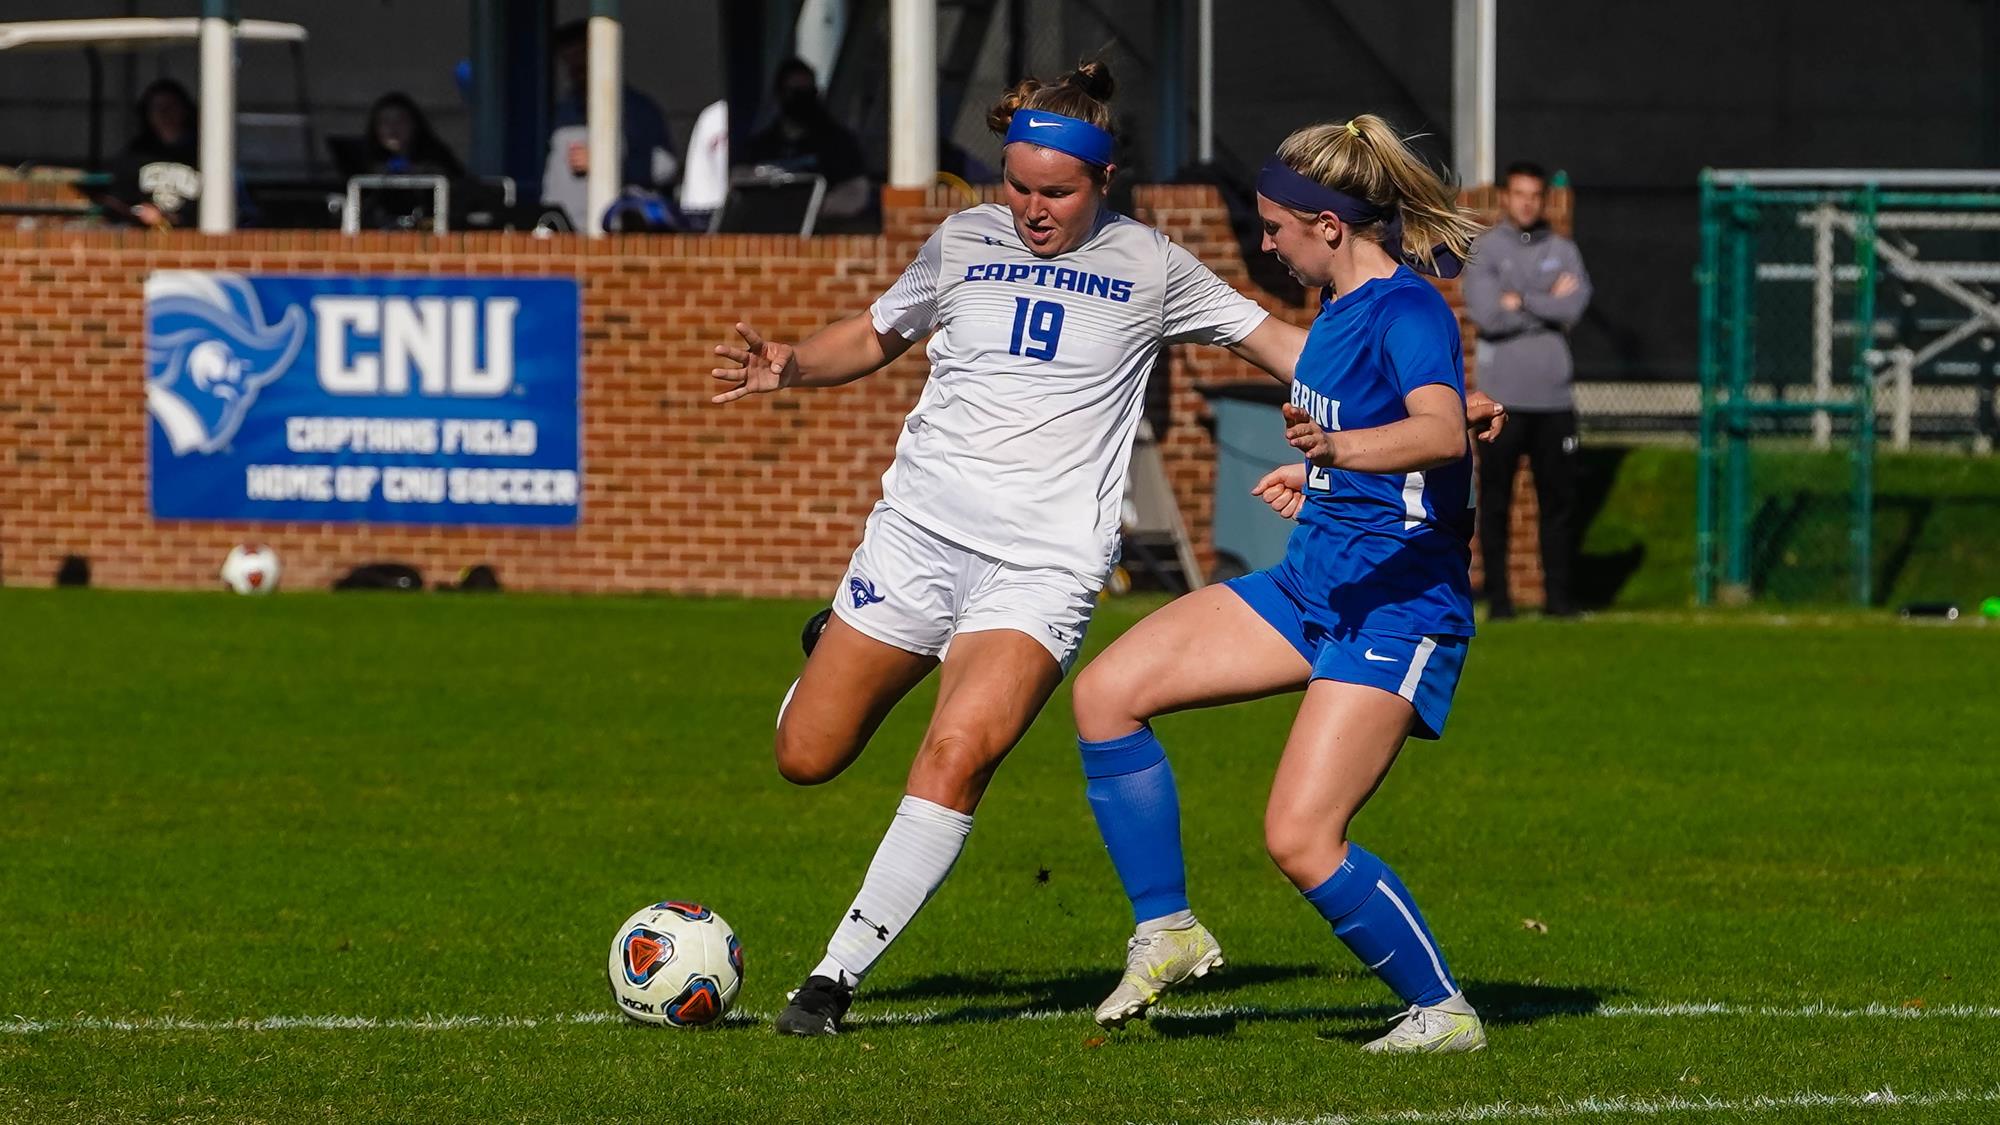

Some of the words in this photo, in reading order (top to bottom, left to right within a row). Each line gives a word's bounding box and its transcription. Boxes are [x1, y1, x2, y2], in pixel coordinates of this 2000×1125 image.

[964, 263, 1136, 303] CAPTAINS
[313, 296, 519, 395] CNU
[1009, 296, 1065, 362] 19
[286, 416, 438, 455] CAPTAINS
[441, 418, 537, 456] FIELD
[246, 464, 334, 502] HOME
[334, 465, 380, 502] OF
[382, 466, 447, 503] CNU
[448, 467, 577, 506] SOCCER
